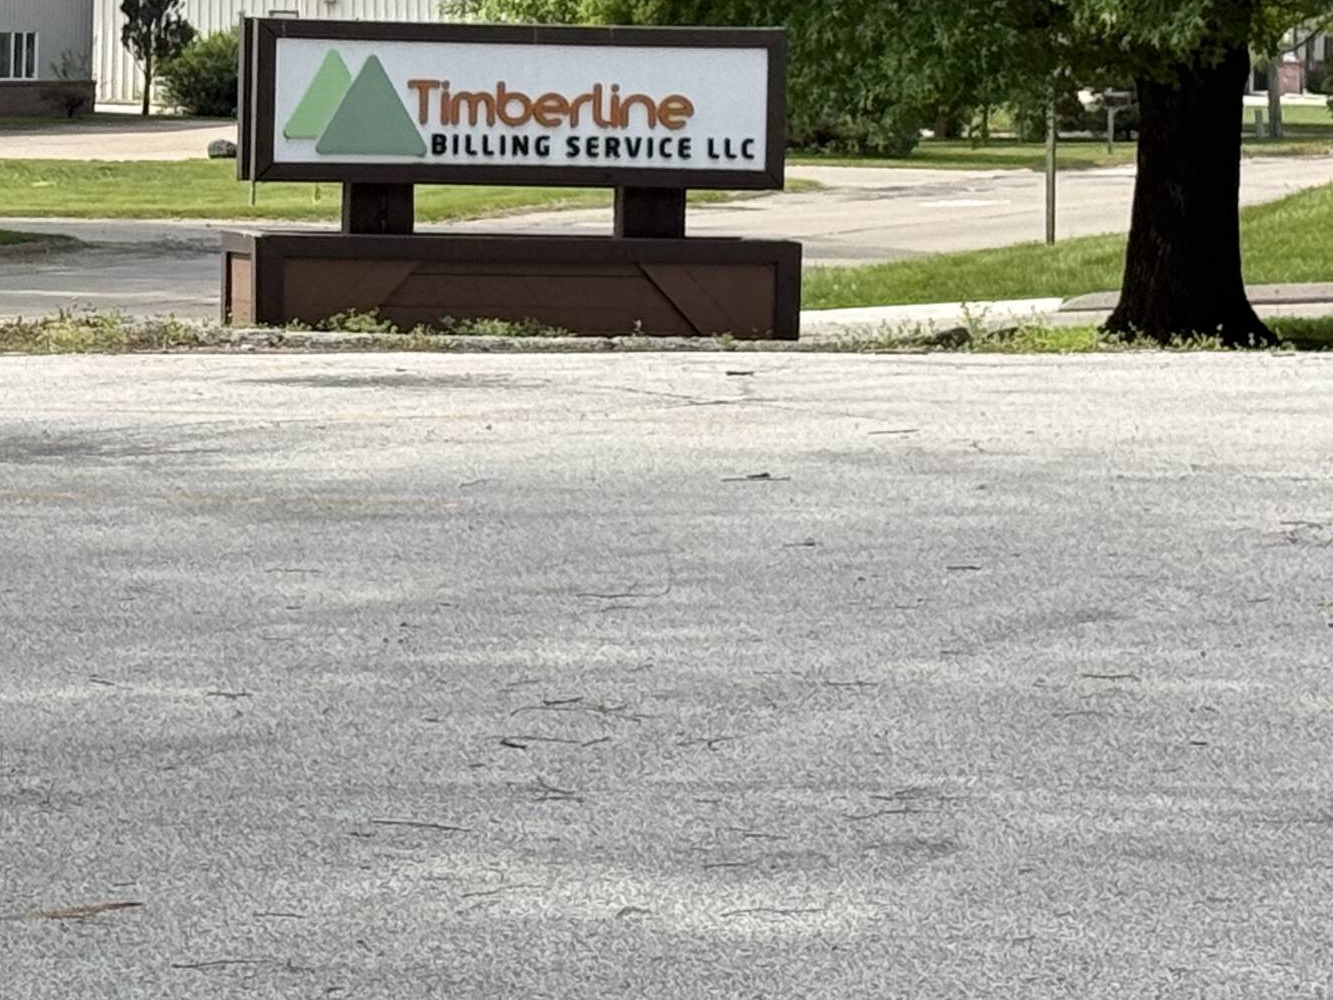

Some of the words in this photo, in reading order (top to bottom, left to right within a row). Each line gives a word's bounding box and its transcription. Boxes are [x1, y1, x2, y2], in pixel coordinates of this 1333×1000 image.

[407, 79, 694, 130] Timberline
[431, 133, 551, 157] BILLING
[565, 136, 692, 159] SERVICE
[707, 137, 756, 160] LLC
